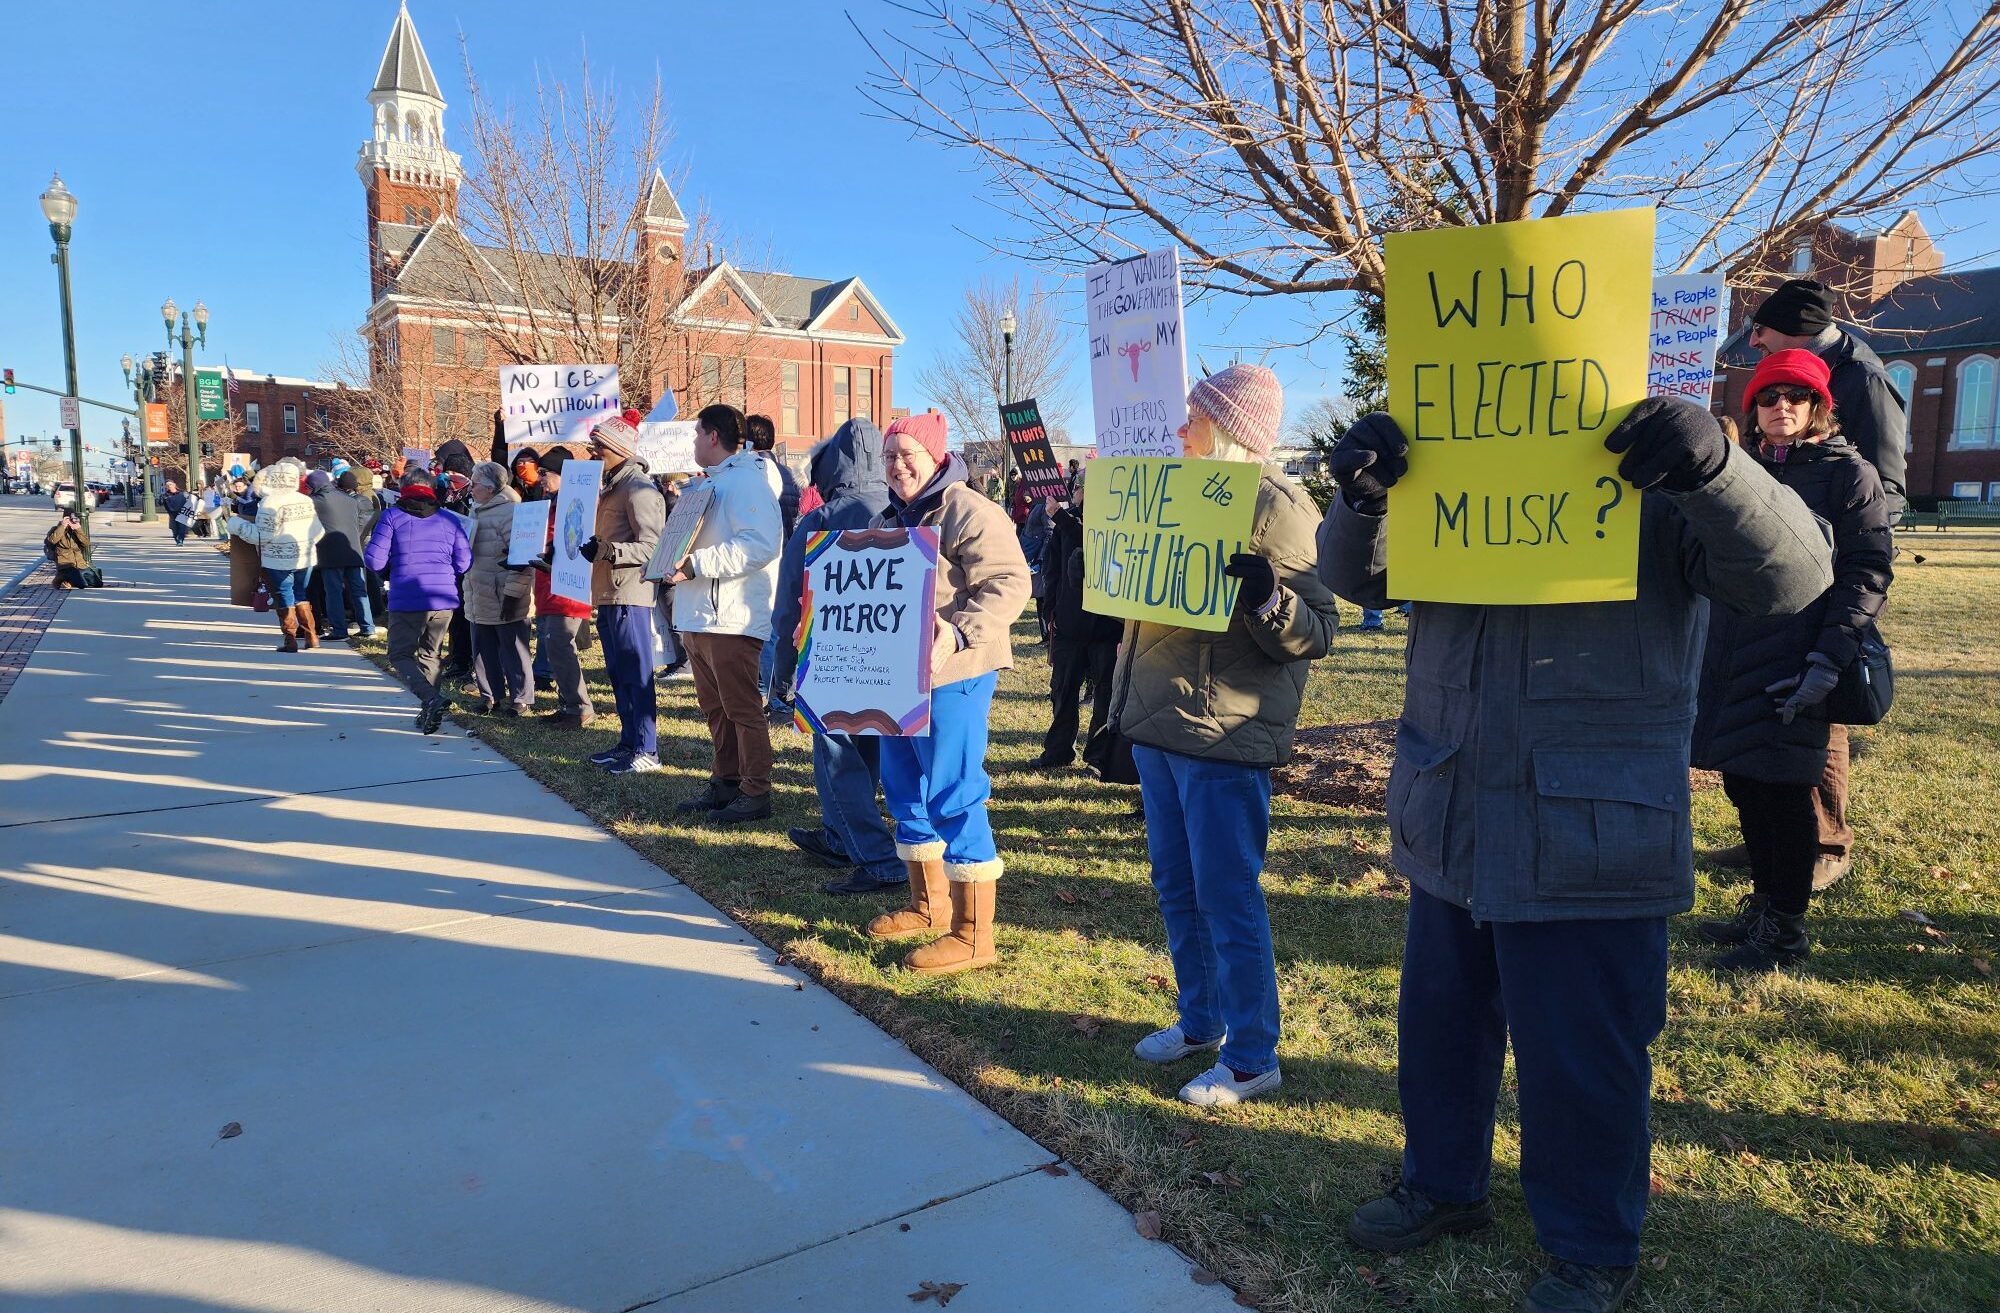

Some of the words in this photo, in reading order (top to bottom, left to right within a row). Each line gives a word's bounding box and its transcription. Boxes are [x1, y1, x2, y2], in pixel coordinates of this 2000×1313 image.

[1090, 268, 1112, 299] IF
[1117, 263, 1125, 291] I
[1130, 250, 1176, 286] WANTED
[1428, 260, 1586, 328] WHO
[1675, 286, 1717, 305] People
[1096, 300, 1114, 320] THE
[1650, 306, 1716, 329] TRUMP
[1090, 333, 1110, 359] IN
[1156, 320, 1177, 346] MY
[1677, 325, 1718, 343] People
[1650, 351, 1702, 370] MUSK
[509, 371, 540, 394] NO
[1677, 367, 1713, 382] People
[529, 393, 601, 415] WITHOUT
[1415, 359, 1609, 441] ELECTED
[1006, 409, 1037, 425] TRANS
[1111, 400, 1167, 428] UTERUS
[521, 420, 566, 437] THE
[1010, 425, 1045, 444] RIGHTS
[1098, 428, 1120, 448] I'D
[1125, 425, 1157, 444] FUCK
[1161, 424, 1175, 443] A
[1023, 448, 1045, 465] ARE
[1024, 467, 1060, 482] HUMAN
[1030, 484, 1067, 498] RIGHTS
[1106, 463, 1182, 528] SAVE
[1201, 472, 1233, 507] the
[824, 557, 904, 595] HAVE
[820, 602, 906, 634] MERCY
